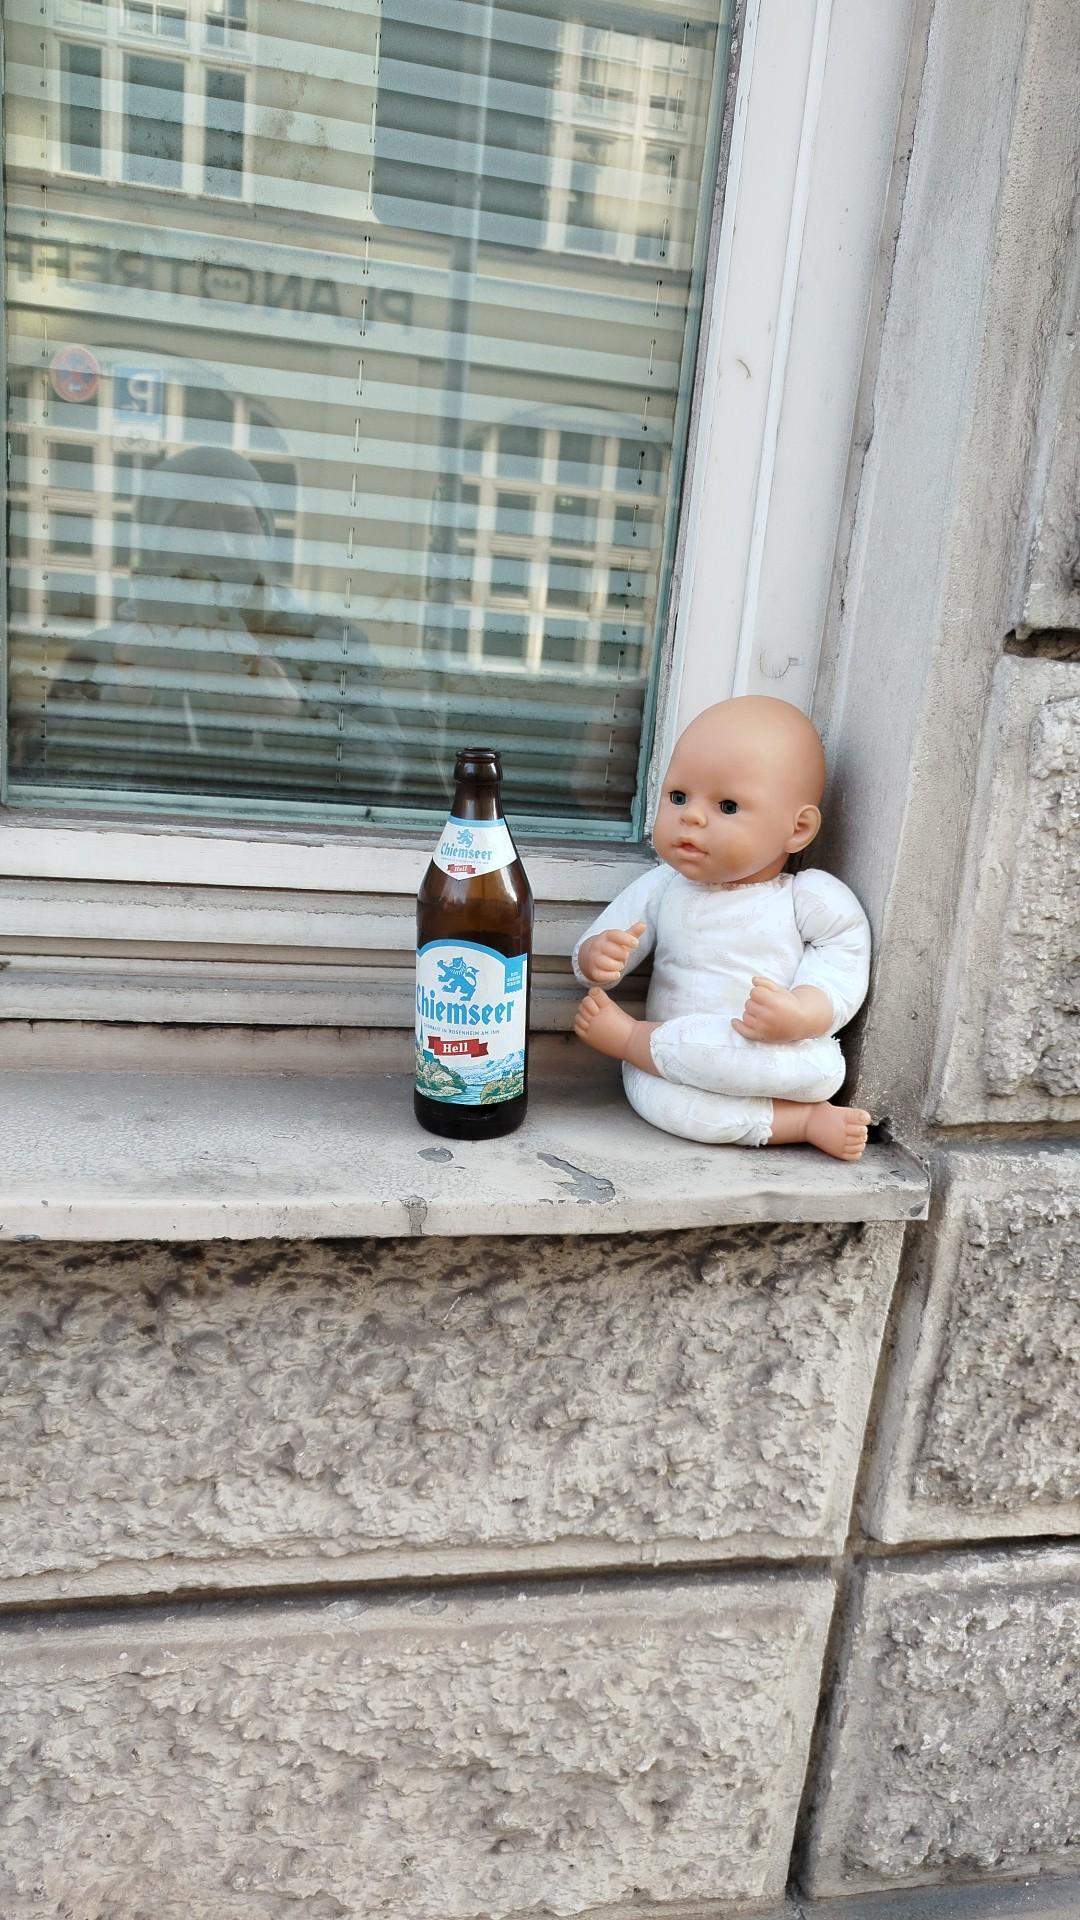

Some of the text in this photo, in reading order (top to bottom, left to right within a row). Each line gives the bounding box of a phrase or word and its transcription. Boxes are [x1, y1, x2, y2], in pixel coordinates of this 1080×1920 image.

[440, 842, 492, 860] Chiemseer
[416, 983, 515, 1025] Chiemseer
[443, 1042, 469, 1053] Hell
